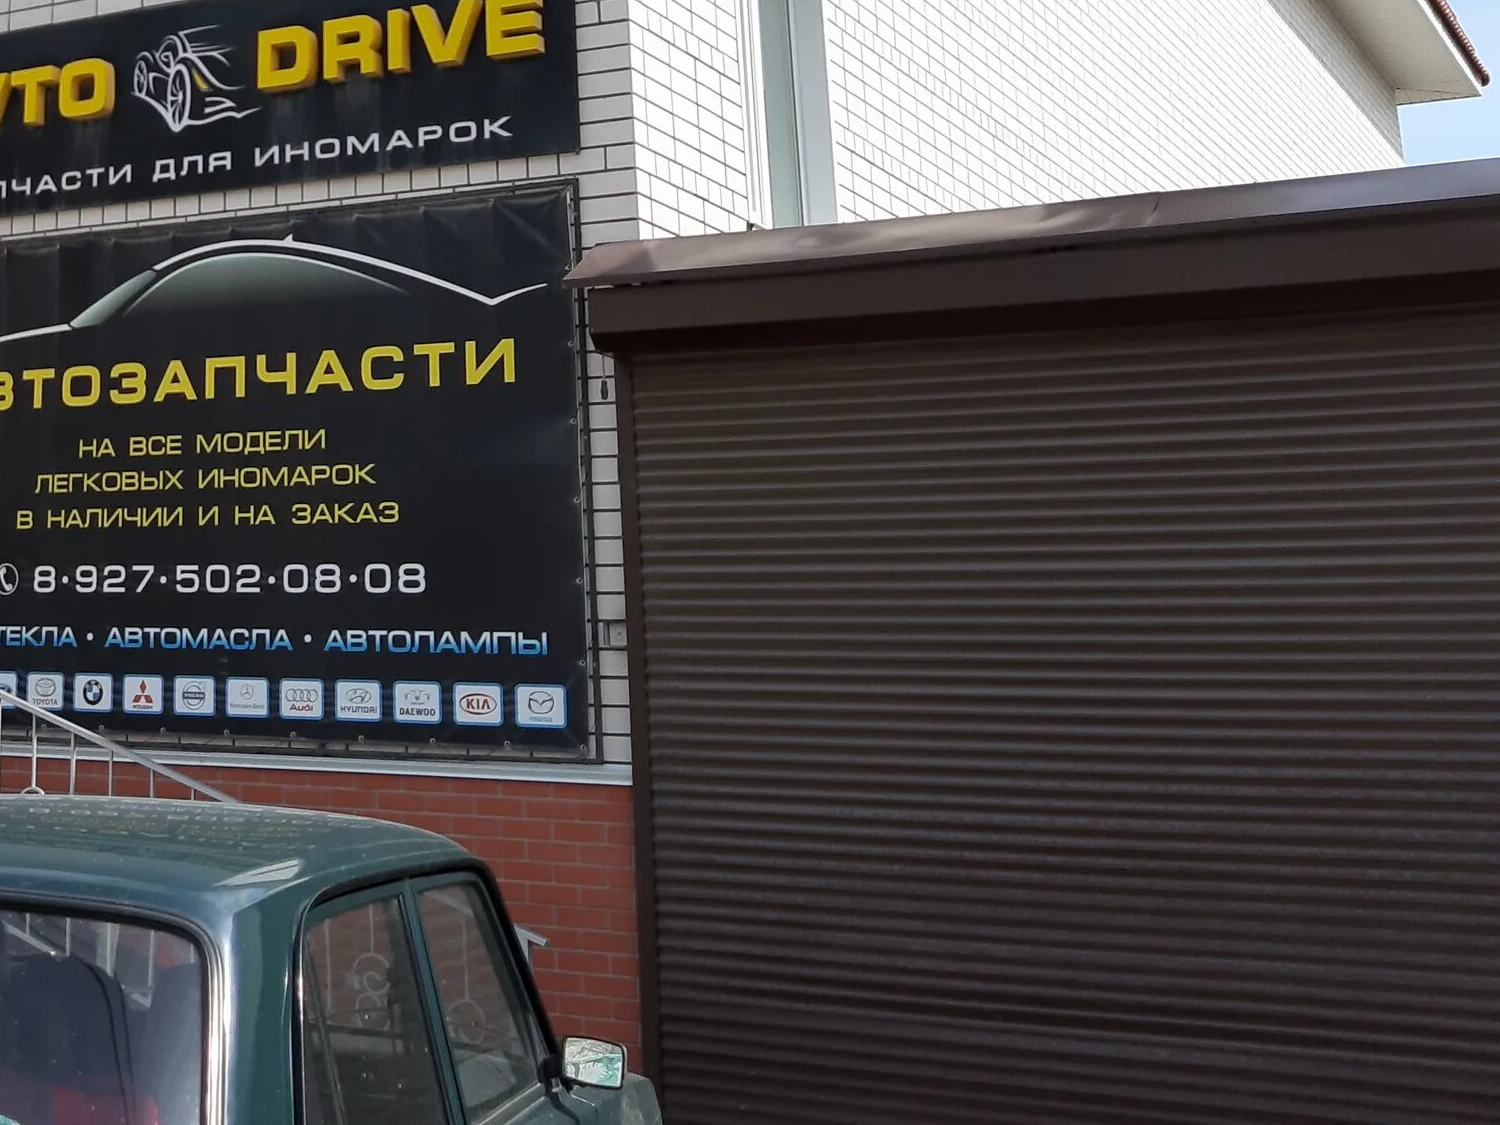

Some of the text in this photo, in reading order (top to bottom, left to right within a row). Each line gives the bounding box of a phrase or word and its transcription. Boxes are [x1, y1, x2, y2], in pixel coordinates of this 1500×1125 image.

[152, 151, 232, 183] ДЛЯ
[254, 115, 514, 168] ИНОМАРОК
[78, 429, 327, 459] НА ВСЕ МОДЕЛИ
[35, 463, 376, 494] ЛЕГКОВЫХ ИНОМАРОК
[16, 501, 400, 530] В НАЛИЧИИ И НА ЗАКАЗ
[104, 627, 293, 651] АВТОМАСЛА
[323, 629, 548, 655] АВТОЛАМПЫ
[32, 698, 58, 706] TOYOTA
[289, 703, 314, 712] Audi
[399, 707, 436, 716] DAEWOO
[466, 698, 491, 710] KIA
